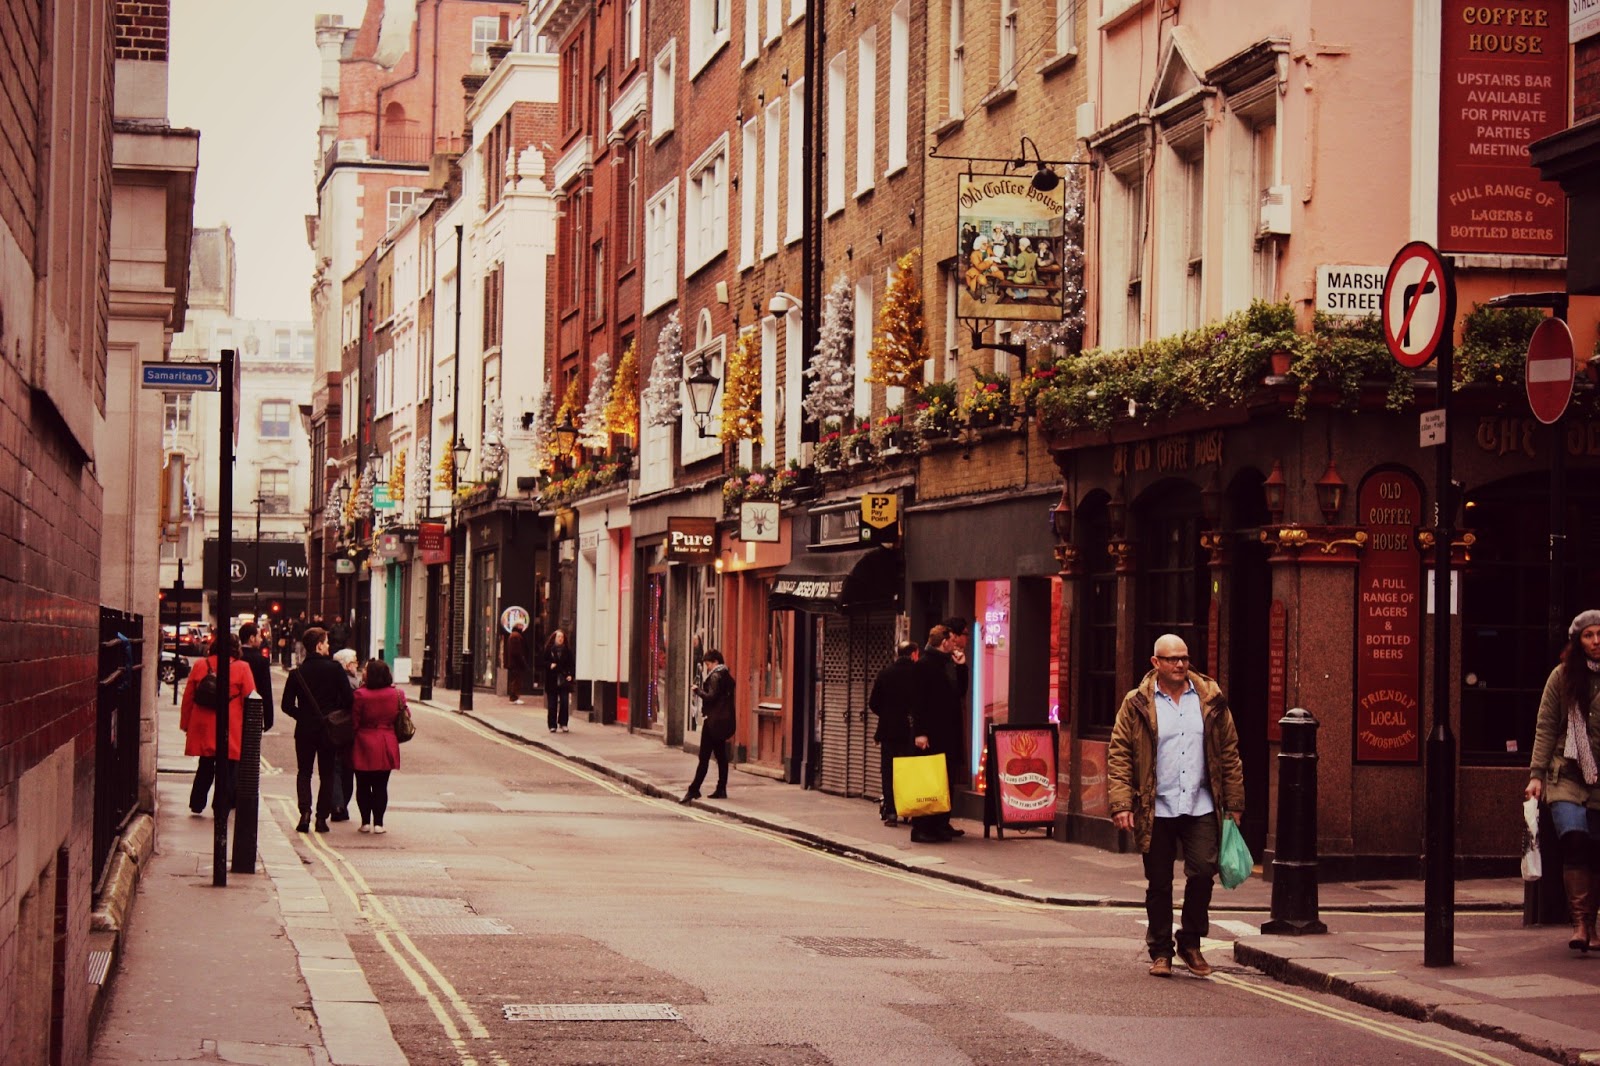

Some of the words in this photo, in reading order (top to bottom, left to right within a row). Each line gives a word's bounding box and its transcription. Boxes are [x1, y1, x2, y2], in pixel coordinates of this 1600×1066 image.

[1463, 6, 1548, 27] COFFEE
[1469, 34, 1542, 53] HOUSE
[1457, 72, 1521, 86] UPSTAIRS
[1525, 75, 1552, 88] BAR
[1467, 91, 1541, 105] AVAILABLE
[1461, 108, 1487, 121] FOR
[1492, 109, 1547, 123] PRIVATE
[1477, 126, 1530, 139] PARTIES
[1469, 143, 1530, 157] MEETING
[960, 187, 983, 209] Old
[983, 179, 1025, 199] Coffee
[1026, 184, 1063, 215] House
[1450, 186, 1481, 207] FULL
[1485, 184, 1533, 200] RANGE
[1535, 192, 1555, 207] OF
[1471, 209, 1523, 222] LAGERS
[1525, 210, 1533, 222] &
[1450, 226, 1508, 239] BOTTLED
[1511, 228, 1554, 240] BEERS
[1327, 272, 1384, 290] MARSH
[1327, 292, 1383, 309] STREET
[147, 370, 203, 381] Samaritans
[1380, 482, 1401, 500] OLD
[1369, 507, 1411, 525] COFFEE
[671, 531, 713, 546] Pure
[1372, 533, 1408, 551] HOUSE
[1372, 578, 1380, 589] A
[1383, 578, 1406, 589] FULL
[1363, 592, 1398, 603] RANGE
[1401, 593, 1414, 603] OF
[1369, 606, 1408, 617] LAGERS
[1384, 621, 1393, 631] &
[1366, 635, 1411, 645] BOTTLED
[1373, 649, 1404, 659] BEERS
[1361, 690, 1416, 709] FRIENDLY
[1371, 711, 1406, 725] LOCAL
[1360, 729, 1416, 749] ATMOSPHERE
